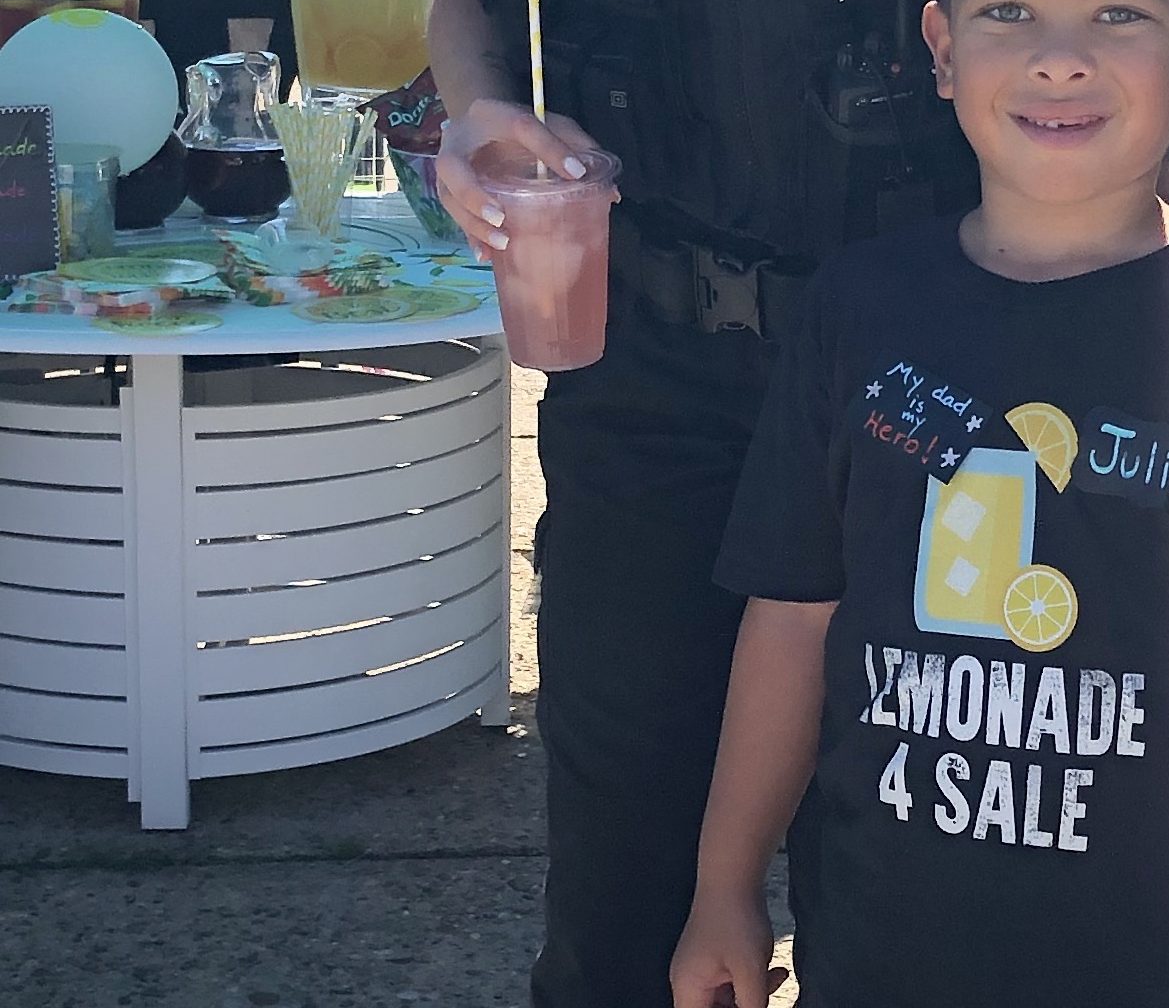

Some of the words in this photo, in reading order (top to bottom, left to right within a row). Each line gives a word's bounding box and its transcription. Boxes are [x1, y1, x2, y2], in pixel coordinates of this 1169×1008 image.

[886, 361, 925, 398] My
[931, 385, 971, 417] dad
[907, 394, 926, 414] is
[863, 409, 939, 466] Hero!
[901, 410, 927, 437] my
[879, 741, 913, 822] 4
[933, 752, 1094, 852] SALE
